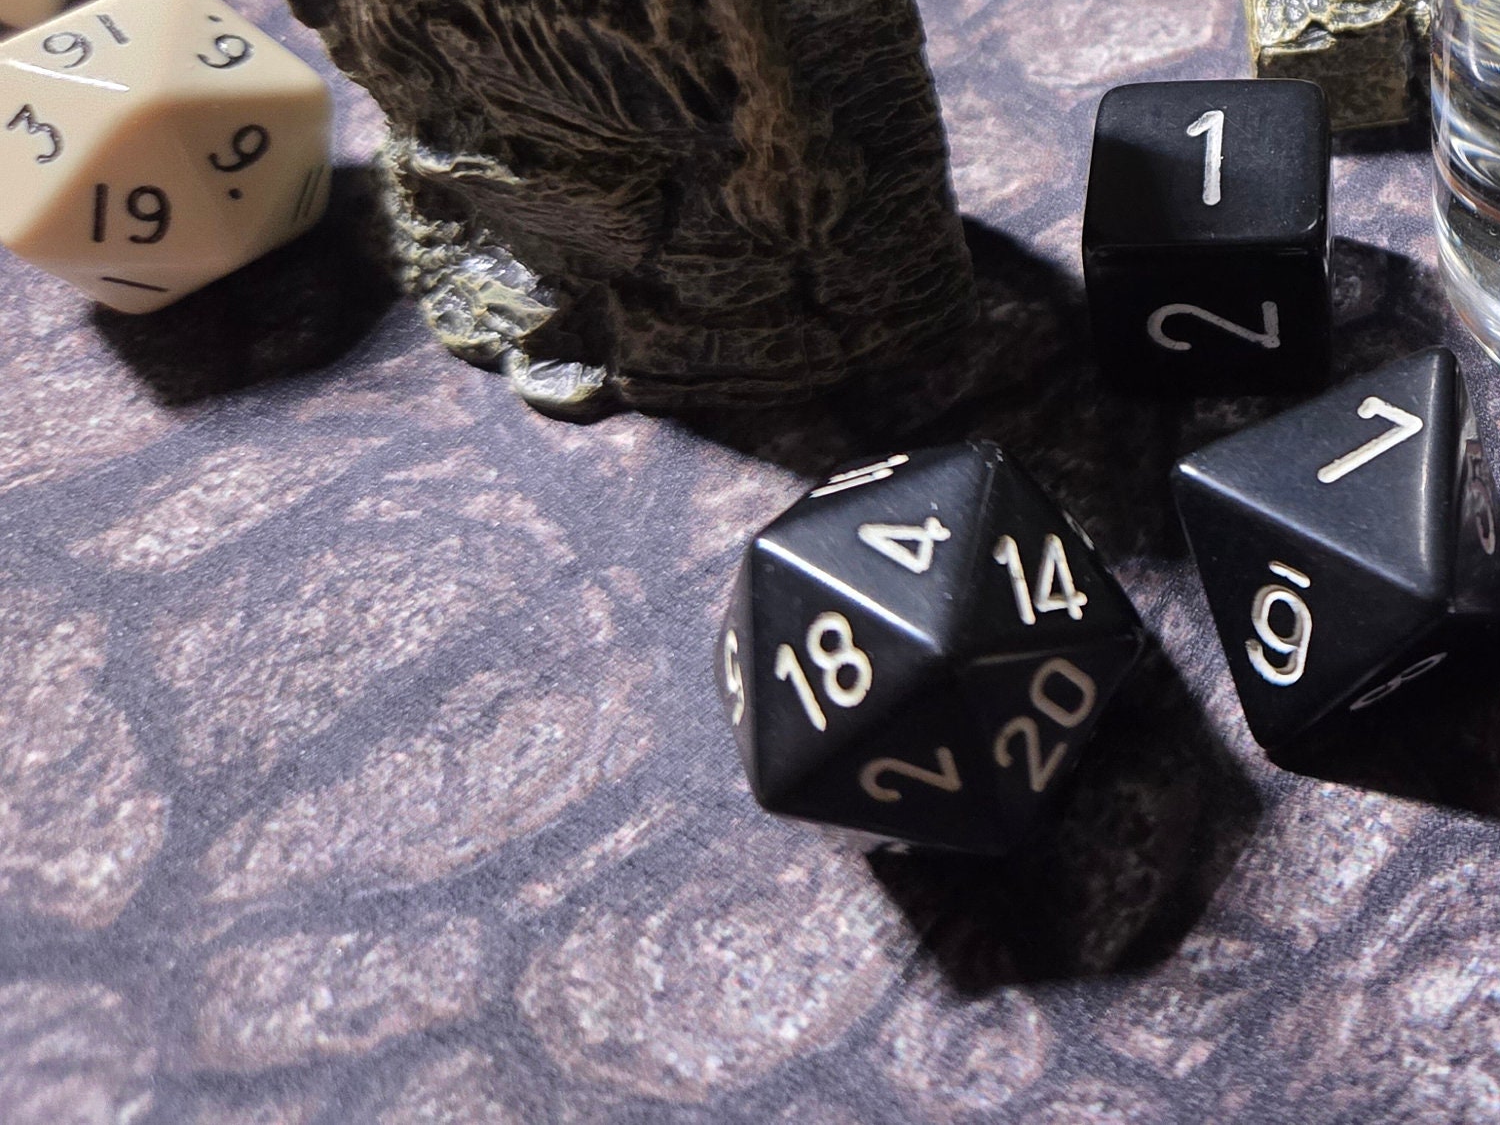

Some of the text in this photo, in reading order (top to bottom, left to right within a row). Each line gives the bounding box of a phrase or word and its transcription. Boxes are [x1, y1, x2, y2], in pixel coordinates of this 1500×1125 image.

[6, 104, 64, 164] 3
[1186, 109, 1225, 206] 1
[93, 183, 172, 244] 19
[1147, 300, 1281, 351] 2
[1318, 396, 1423, 484] 7
[857, 516, 952, 574] 4
[993, 533, 1088, 625] 14
[775, 611, 873, 732] 18
[993, 656, 1097, 793] 20
[858, 746, 963, 803] 2
